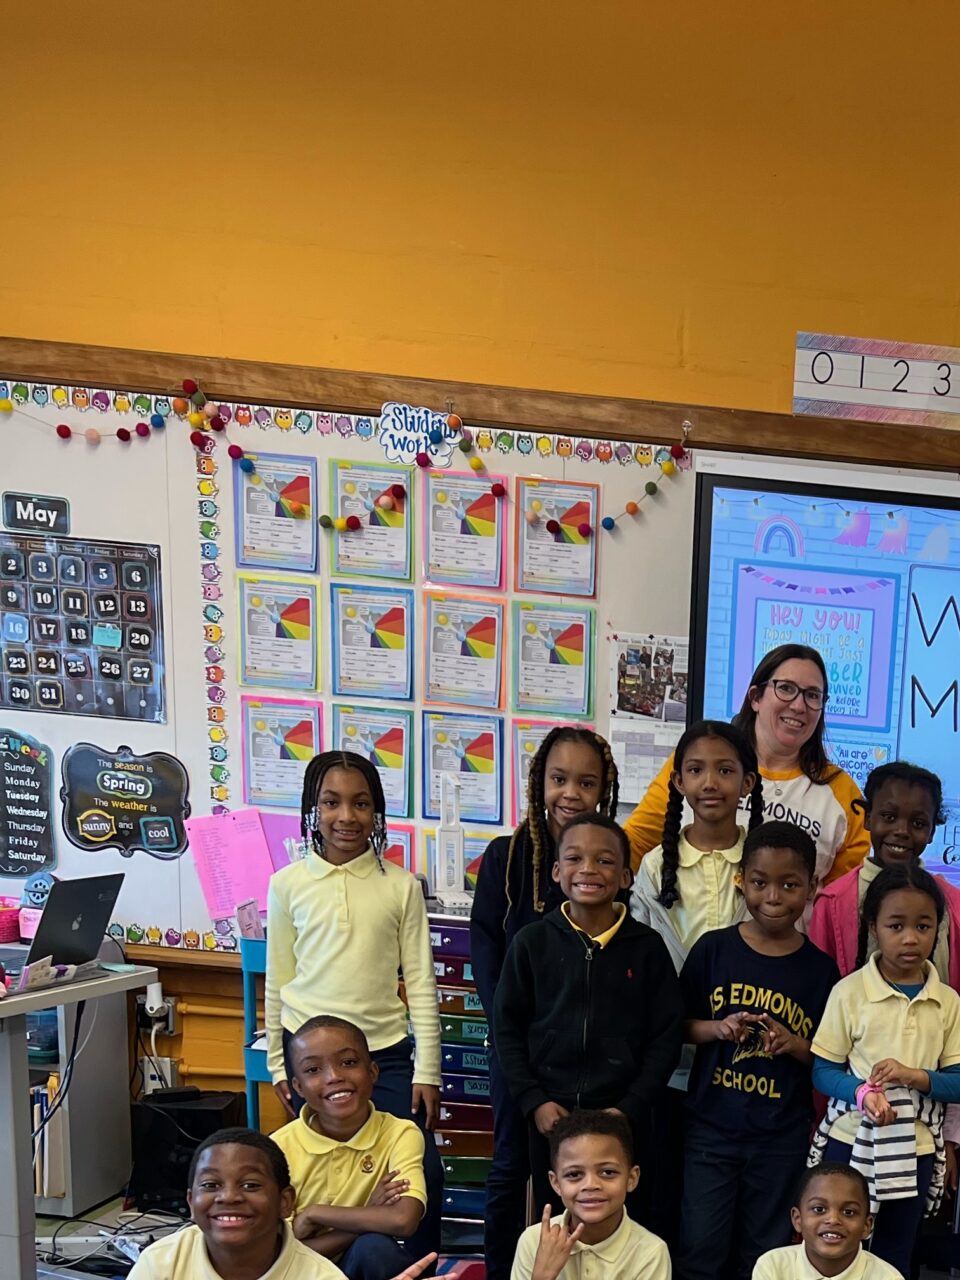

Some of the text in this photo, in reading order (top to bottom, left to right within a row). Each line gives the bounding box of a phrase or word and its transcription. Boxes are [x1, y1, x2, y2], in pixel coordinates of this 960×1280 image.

[811, 351, 834, 384] 0
[892, 360, 910, 393] 2
[933, 363, 951, 396] 3
[15, 501, 58, 528] May
[7, 559, 142, 582] 2 3 4 5 6
[7, 590, 146, 612] 9 10 11 12 13
[9, 622, 150, 645] 16 17 18 20
[9, 657, 150, 679] 23 24 25 26 27
[11, 687, 57, 700] 30 31
[851, 750, 868, 760] are
[4, 762, 36, 774] Sunday
[97, 759, 153, 773] The season is
[5, 777, 41, 789] Monday
[103, 774, 145, 794] Spring
[5, 790, 40, 803] Tuesday
[6, 806, 48, 819] Wednesday
[94, 798, 157, 813] The weather is
[7, 821, 46, 833] Thursday
[82, 821, 170, 838] sunny and cool
[9, 837, 39, 848] Friday
[7, 851, 46, 863] Saturday
[730, 983, 813, 1039] EDMONDS
[712, 1066, 781, 1098] SCHOOL
